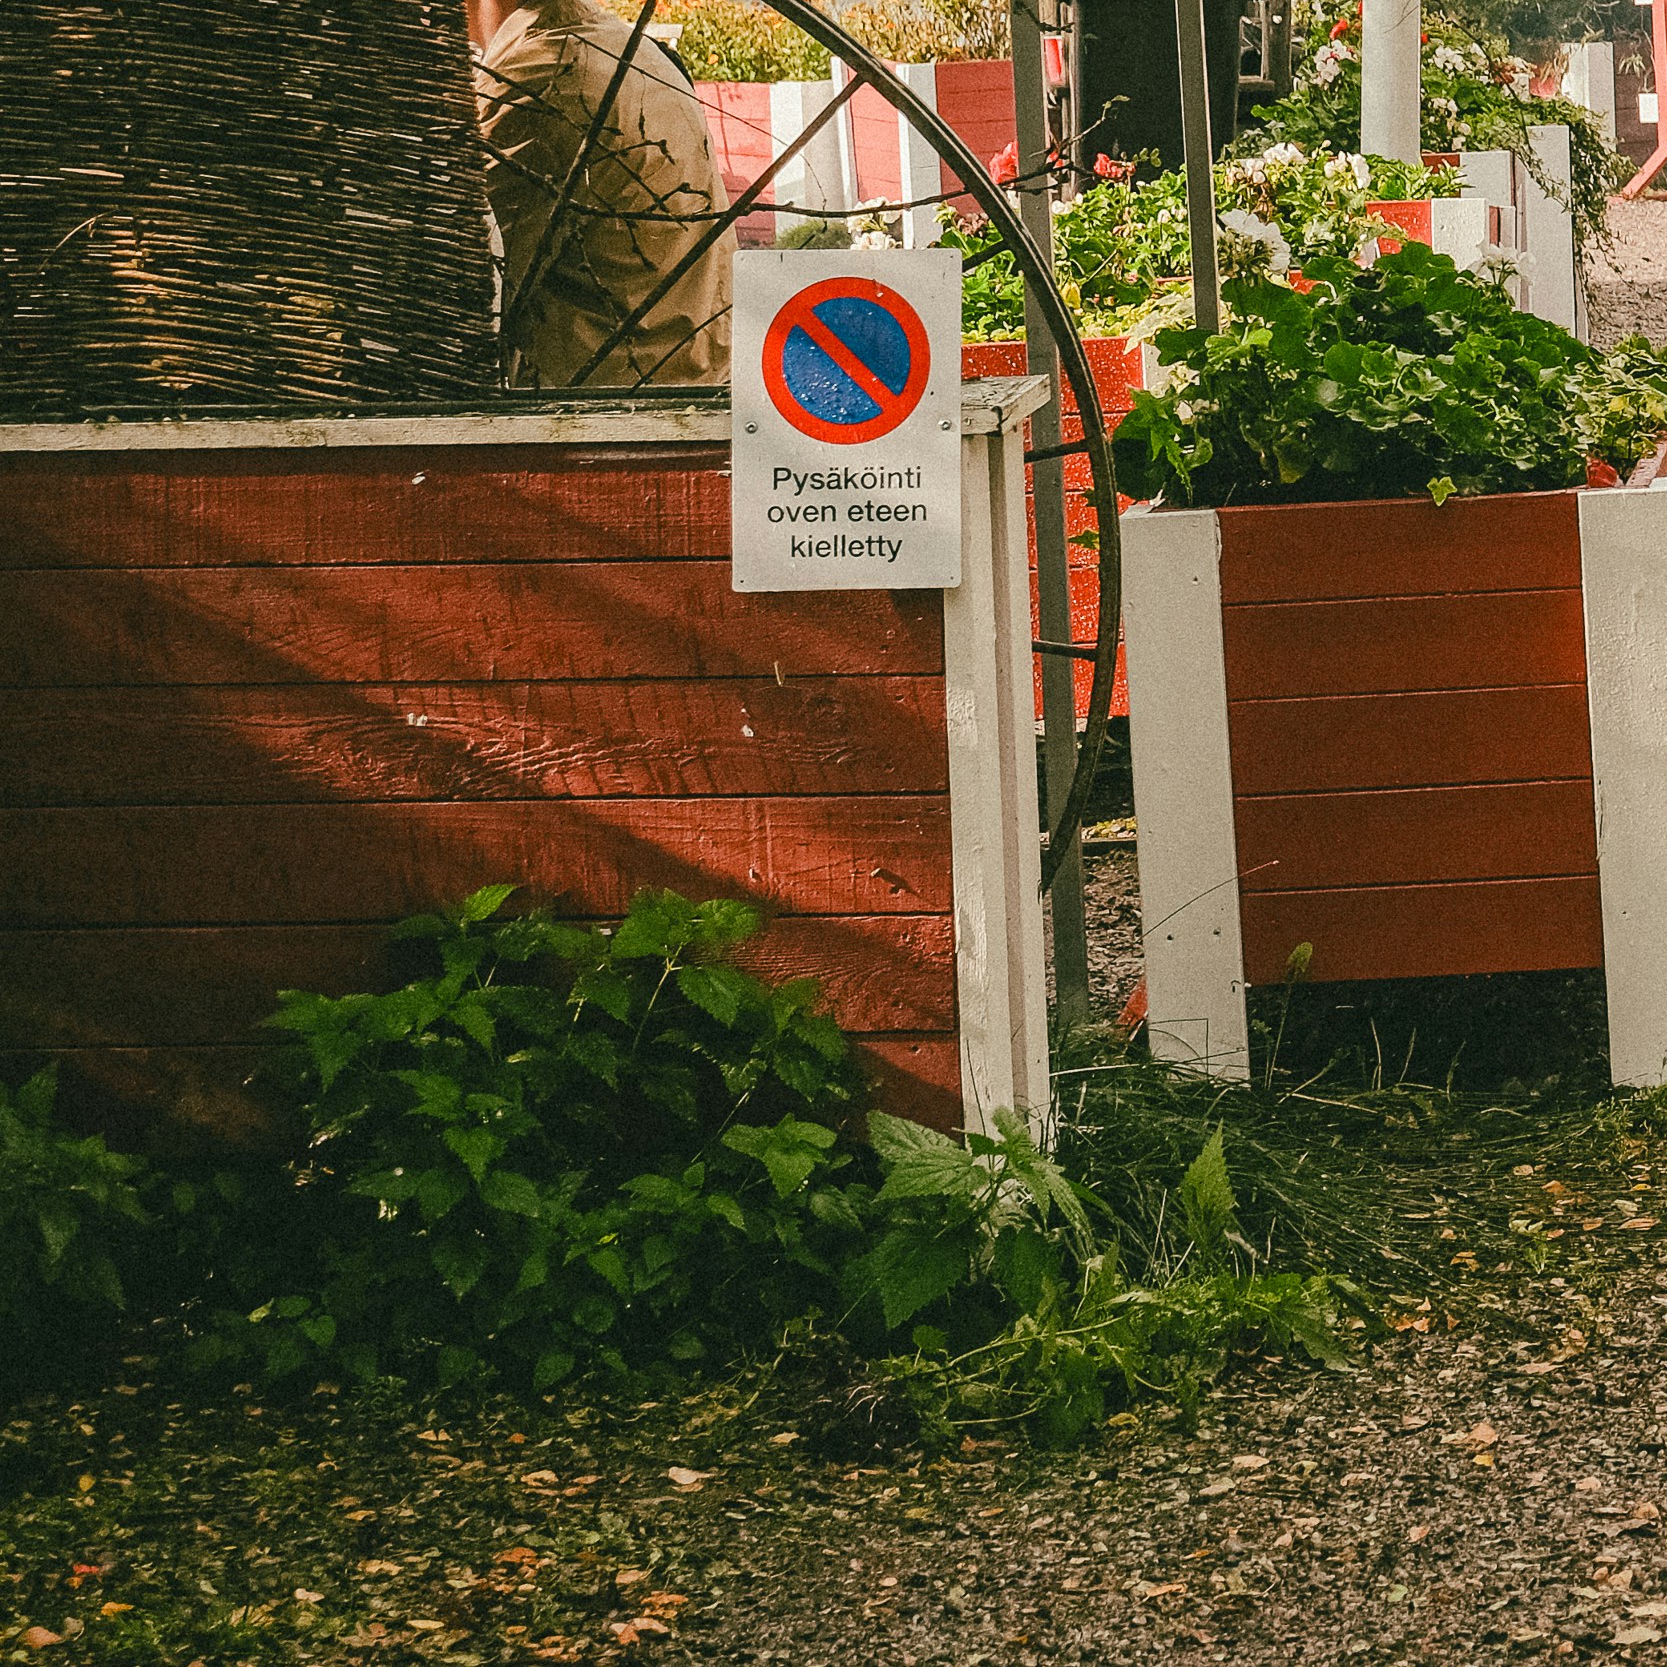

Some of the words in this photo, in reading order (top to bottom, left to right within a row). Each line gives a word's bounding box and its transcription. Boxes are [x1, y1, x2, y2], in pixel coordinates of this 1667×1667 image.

[772, 465, 922, 497] Pysäköinti
[766, 505, 837, 523] oven
[847, 499, 928, 523] eteen
[790, 534, 903, 564] kielletty
